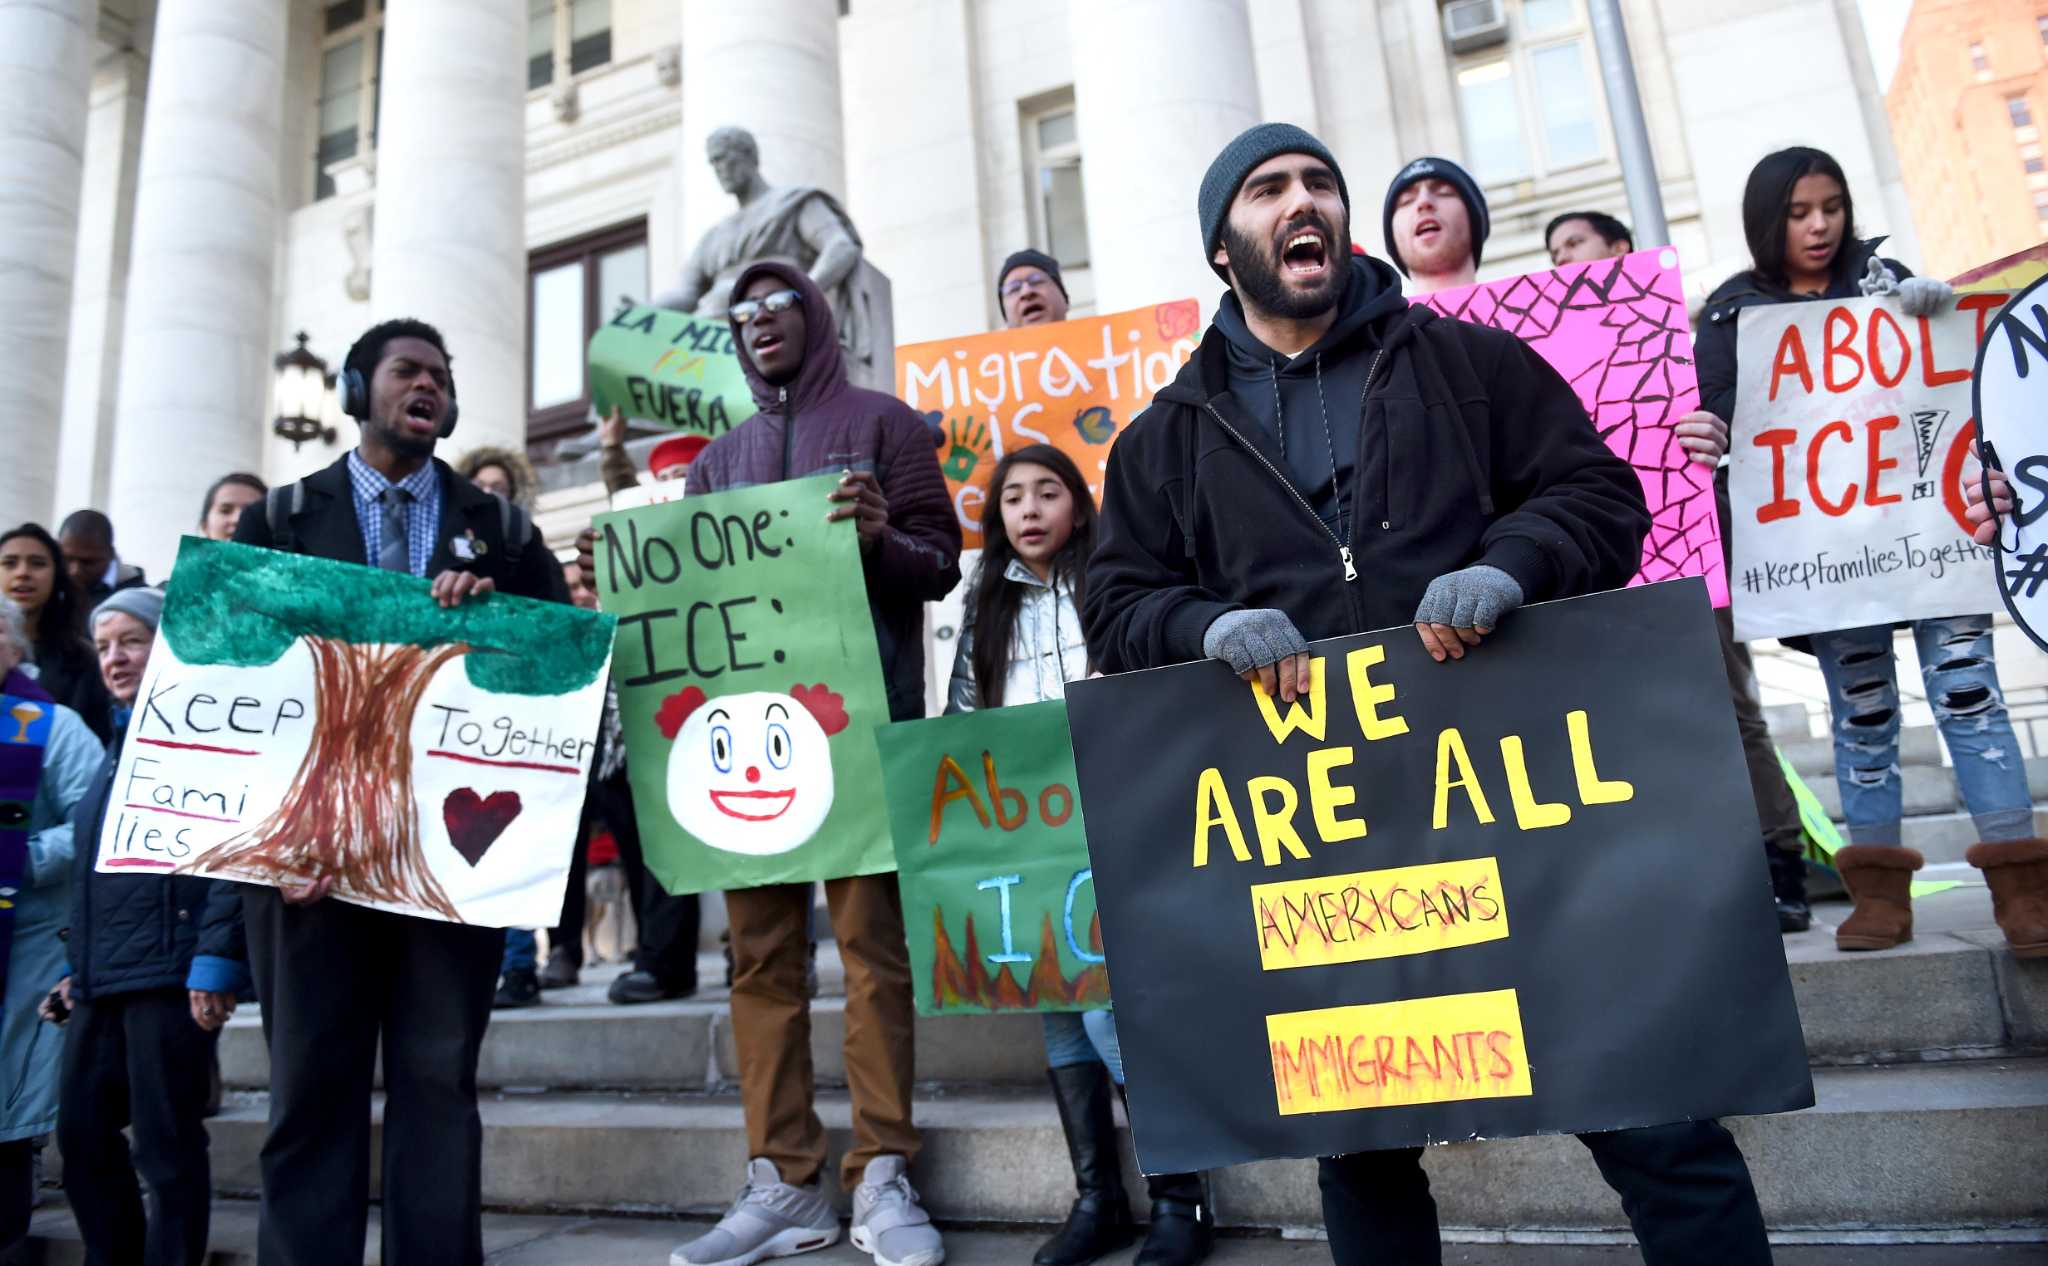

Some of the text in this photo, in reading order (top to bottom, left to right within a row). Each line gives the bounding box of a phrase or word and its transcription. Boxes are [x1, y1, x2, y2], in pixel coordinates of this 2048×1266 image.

[610, 294, 657, 335] LA
[626, 376, 731, 435] FUERA
[603, 510, 795, 594] No One:
[1741, 532, 1996, 595] #KeepFamiliesTogethe
[618, 596, 786, 687] ICE:
[1250, 644, 1410, 744] WE
[431, 703, 595, 763] Together
[126, 756, 249, 816] Fami
[927, 749, 1074, 846] Abo
[1192, 710, 1635, 867] ARE ALL
[113, 811, 192, 858] lies
[976, 867, 1106, 964] IC
[1259, 884, 1500, 950] AMERICANS
[1272, 1030, 1515, 1101] IMMIGRANTS
